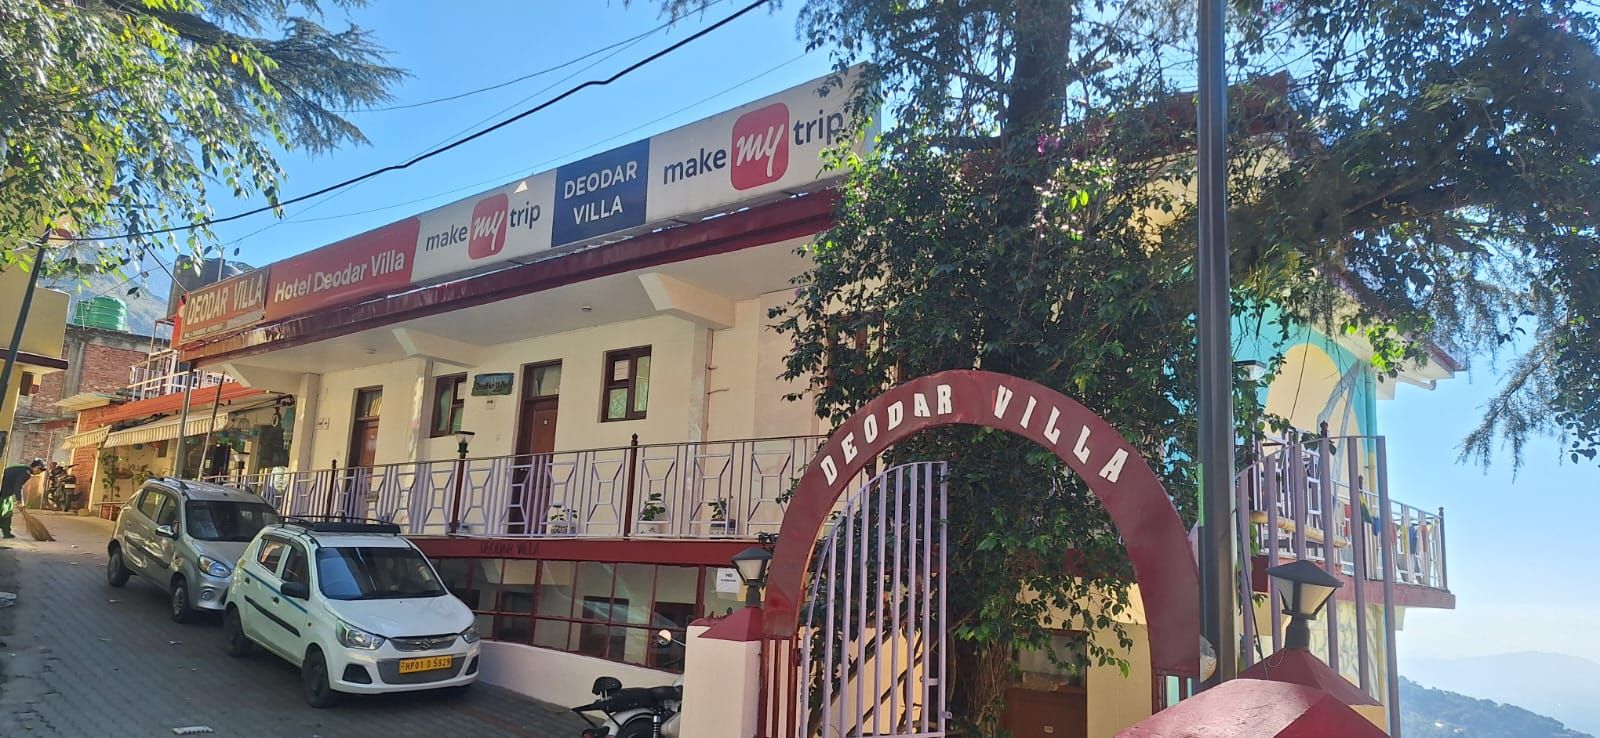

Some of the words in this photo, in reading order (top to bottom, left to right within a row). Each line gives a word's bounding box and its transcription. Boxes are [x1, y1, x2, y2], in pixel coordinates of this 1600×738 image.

[663, 147, 726, 186] make
[736, 123, 785, 178] my
[793, 108, 844, 146] trip
[563, 160, 638, 200] DEODAR
[425, 223, 468, 252] make
[473, 208, 505, 252] my
[509, 201, 541, 229] trip
[573, 197, 623, 225] VILLA
[186, 287, 229, 326] DEODAR
[233, 273, 263, 312] VILLA
[274, 277, 311, 303] Hotel
[313, 262, 368, 293] Deodar
[371, 249, 405, 277] Villa
[820, 383, 953, 487] DEODAR
[993, 384, 1129, 483] VILLA
